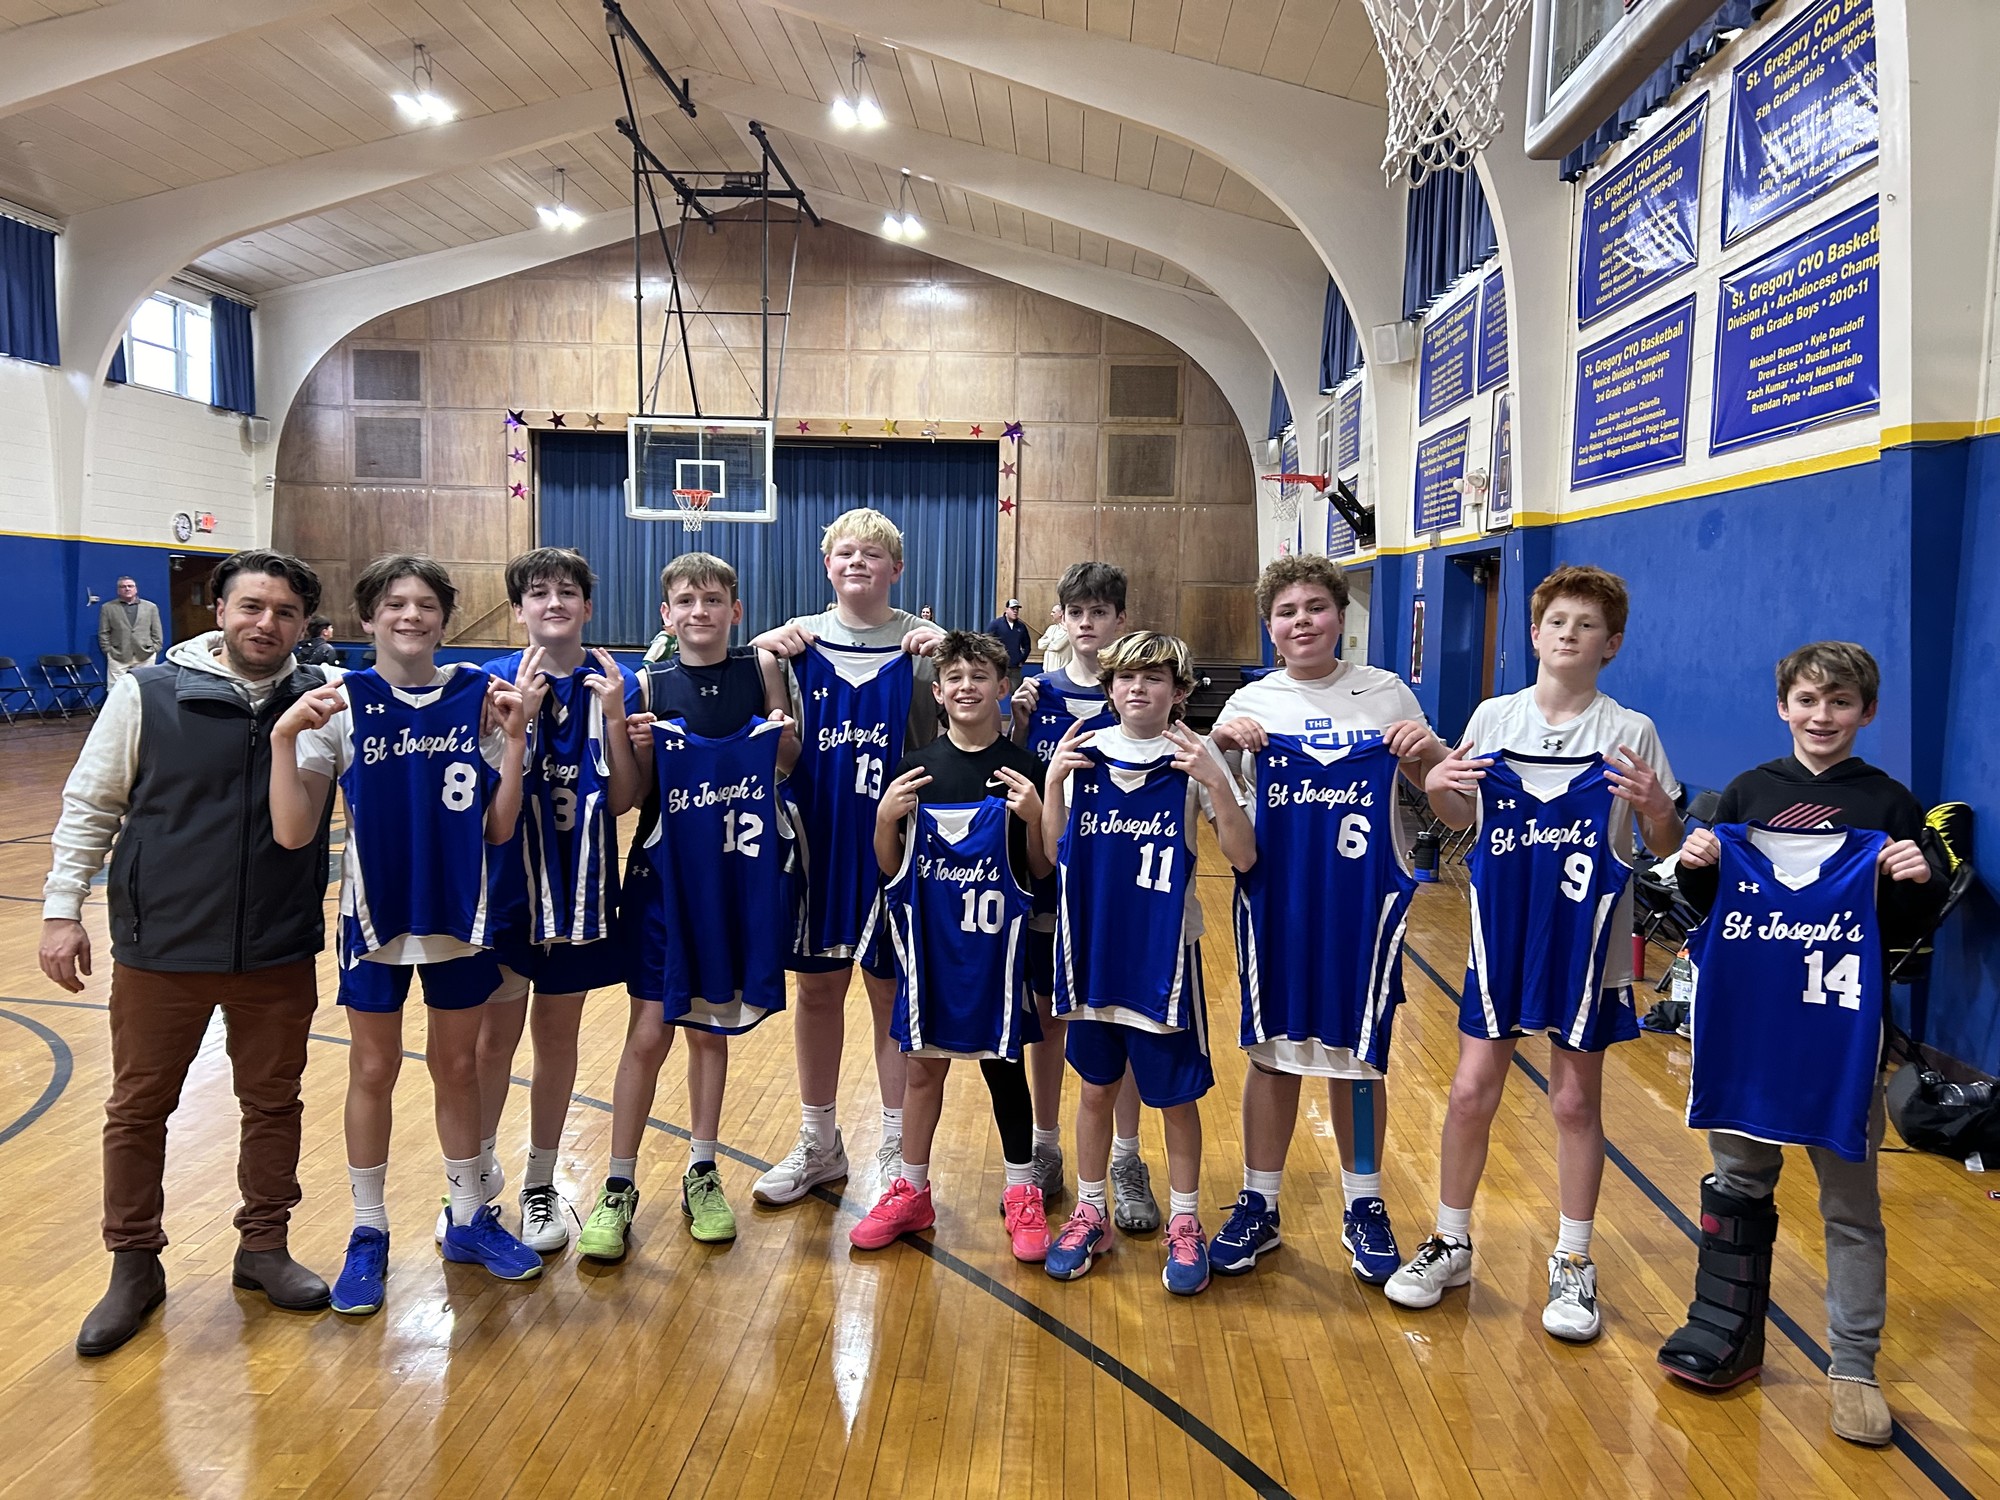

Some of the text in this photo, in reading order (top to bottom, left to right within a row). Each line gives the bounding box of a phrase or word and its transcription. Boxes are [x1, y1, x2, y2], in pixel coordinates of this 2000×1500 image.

[1746, 70, 1761, 91] St.
[1764, 31, 1810, 77] Gregory
[1814, 4, 1840, 37] CYO
[1774, 55, 1808, 89] Division
[1811, 45, 1818, 60] C
[1755, 102, 1771, 122] 5th
[1773, 82, 1800, 109] Grade
[1803, 64, 1824, 87] Girls
[1829, 72, 1861, 101] Jessica
[1605, 171, 1633, 201] Gregory
[1635, 155, 1651, 178] CYO
[1652, 118, 1696, 165] Basketball
[1782, 177, 1801, 195] Pyne
[1809, 152, 1837, 178] Rachel
[1611, 160, 1672, 212] Division A Champions
[1610, 209, 1626, 227] Grade
[1628, 199, 1641, 214] Girls
[1727, 308, 1760, 331] Division
[1762, 301, 1768, 316] A
[1776, 272, 1837, 309] Archdiocese
[1732, 291, 1746, 309] St.
[1749, 268, 1794, 301] Gregory
[1798, 250, 1824, 277] CYO
[1750, 277, 1868, 340] 8th Grade Boys 2010-11
[1585, 320, 1683, 378] St. Gregory CYO Basketball
[1749, 315, 1865, 369] Michael Bronzo Kyle Davidoff
[1758, 339, 1851, 381] Drew Estes Dustin Hart
[1593, 350, 1670, 390] Novice Division Champions
[1596, 367, 1663, 403] 3rd Grade Girls 2010-11
[1746, 353, 1863, 401] Zach Kumar Joey Nannariello
[1752, 371, 1854, 414] Brendan Pyne James Wolf
[363, 725, 475, 765] St Joseph's
[818, 720, 888, 751] St Joseph's
[1308, 720, 1330, 728] THE
[1037, 740, 1055, 762] St
[441, 761, 477, 812] 8
[668, 775, 765, 813] St Joseph's
[855, 753, 884, 800] 13
[1268, 779, 1373, 810] St Joseph's
[550, 787, 577, 831] 3
[1080, 809, 1177, 841] St Joseph's
[723, 809, 763, 858] 12
[1337, 813, 1371, 860] 6
[1490, 818, 1597, 856] St Joseph's
[917, 854, 1000, 888] St Joseph's
[1136, 842, 1174, 894] 11
[1560, 852, 1594, 902] 9
[960, 888, 1005, 934] 10
[1722, 910, 1864, 948] St Joseph's
[1802, 950, 1862, 1011] 14
